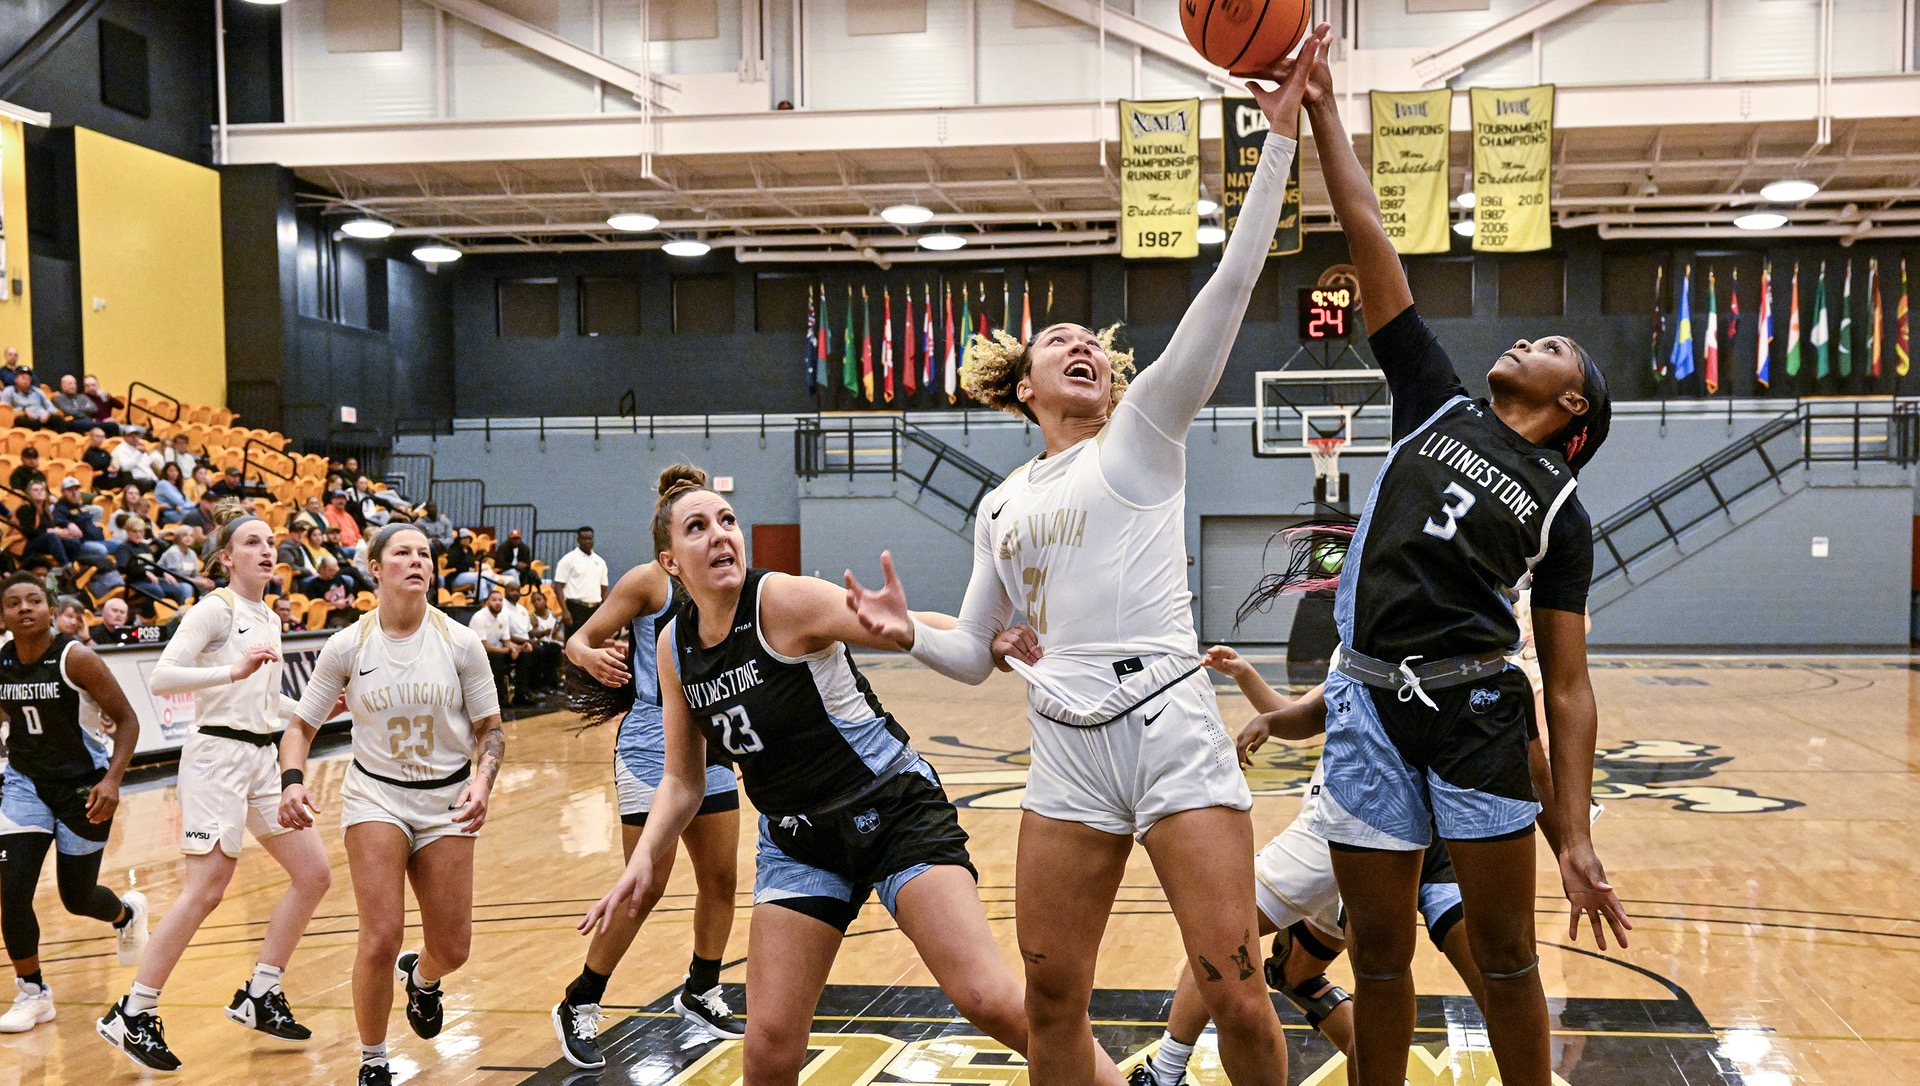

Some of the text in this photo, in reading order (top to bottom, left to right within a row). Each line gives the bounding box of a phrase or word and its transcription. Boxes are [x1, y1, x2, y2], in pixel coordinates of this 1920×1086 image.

[1236, 105, 1271, 138] CIA
[1478, 120, 1548, 134] TOURNAMENT
[1380, 124, 1444, 136] CHAMPIONS
[1480, 133, 1547, 146] CHAMPIONS
[1133, 144, 1186, 155] NATIONAL
[1121, 155, 1198, 168] CHAMPIONSHIP
[1377, 160, 1444, 174] Basketball
[1478, 168, 1546, 184] Basketball
[1380, 186, 1405, 196] 1963
[1380, 199, 1405, 209] 1987
[1481, 196, 1502, 206] 1961
[1518, 194, 1543, 205] 2010
[1127, 203, 1193, 217] Basketball
[1481, 210, 1505, 220] 1987
[1481, 222, 1508, 233] 2006
[1138, 231, 1182, 247] 1987
[1481, 235, 1508, 246] 2007
[1311, 289, 1350, 308] 9:40
[1308, 308, 1343, 337] 24
[1538, 457, 1560, 476] CIAA
[1418, 432, 1539, 525] LIVINGSTONE
[1422, 481, 1476, 541] 3
[138, 626, 160, 639] POSS
[1123, 663, 1133, 672] L
[360, 682, 455, 714] WEST VIRGINIA
[22, 706, 43, 735] 0
[710, 704, 765, 755] 23
[387, 714, 434, 760] 23
[185, 831, 210, 840] WVSU
